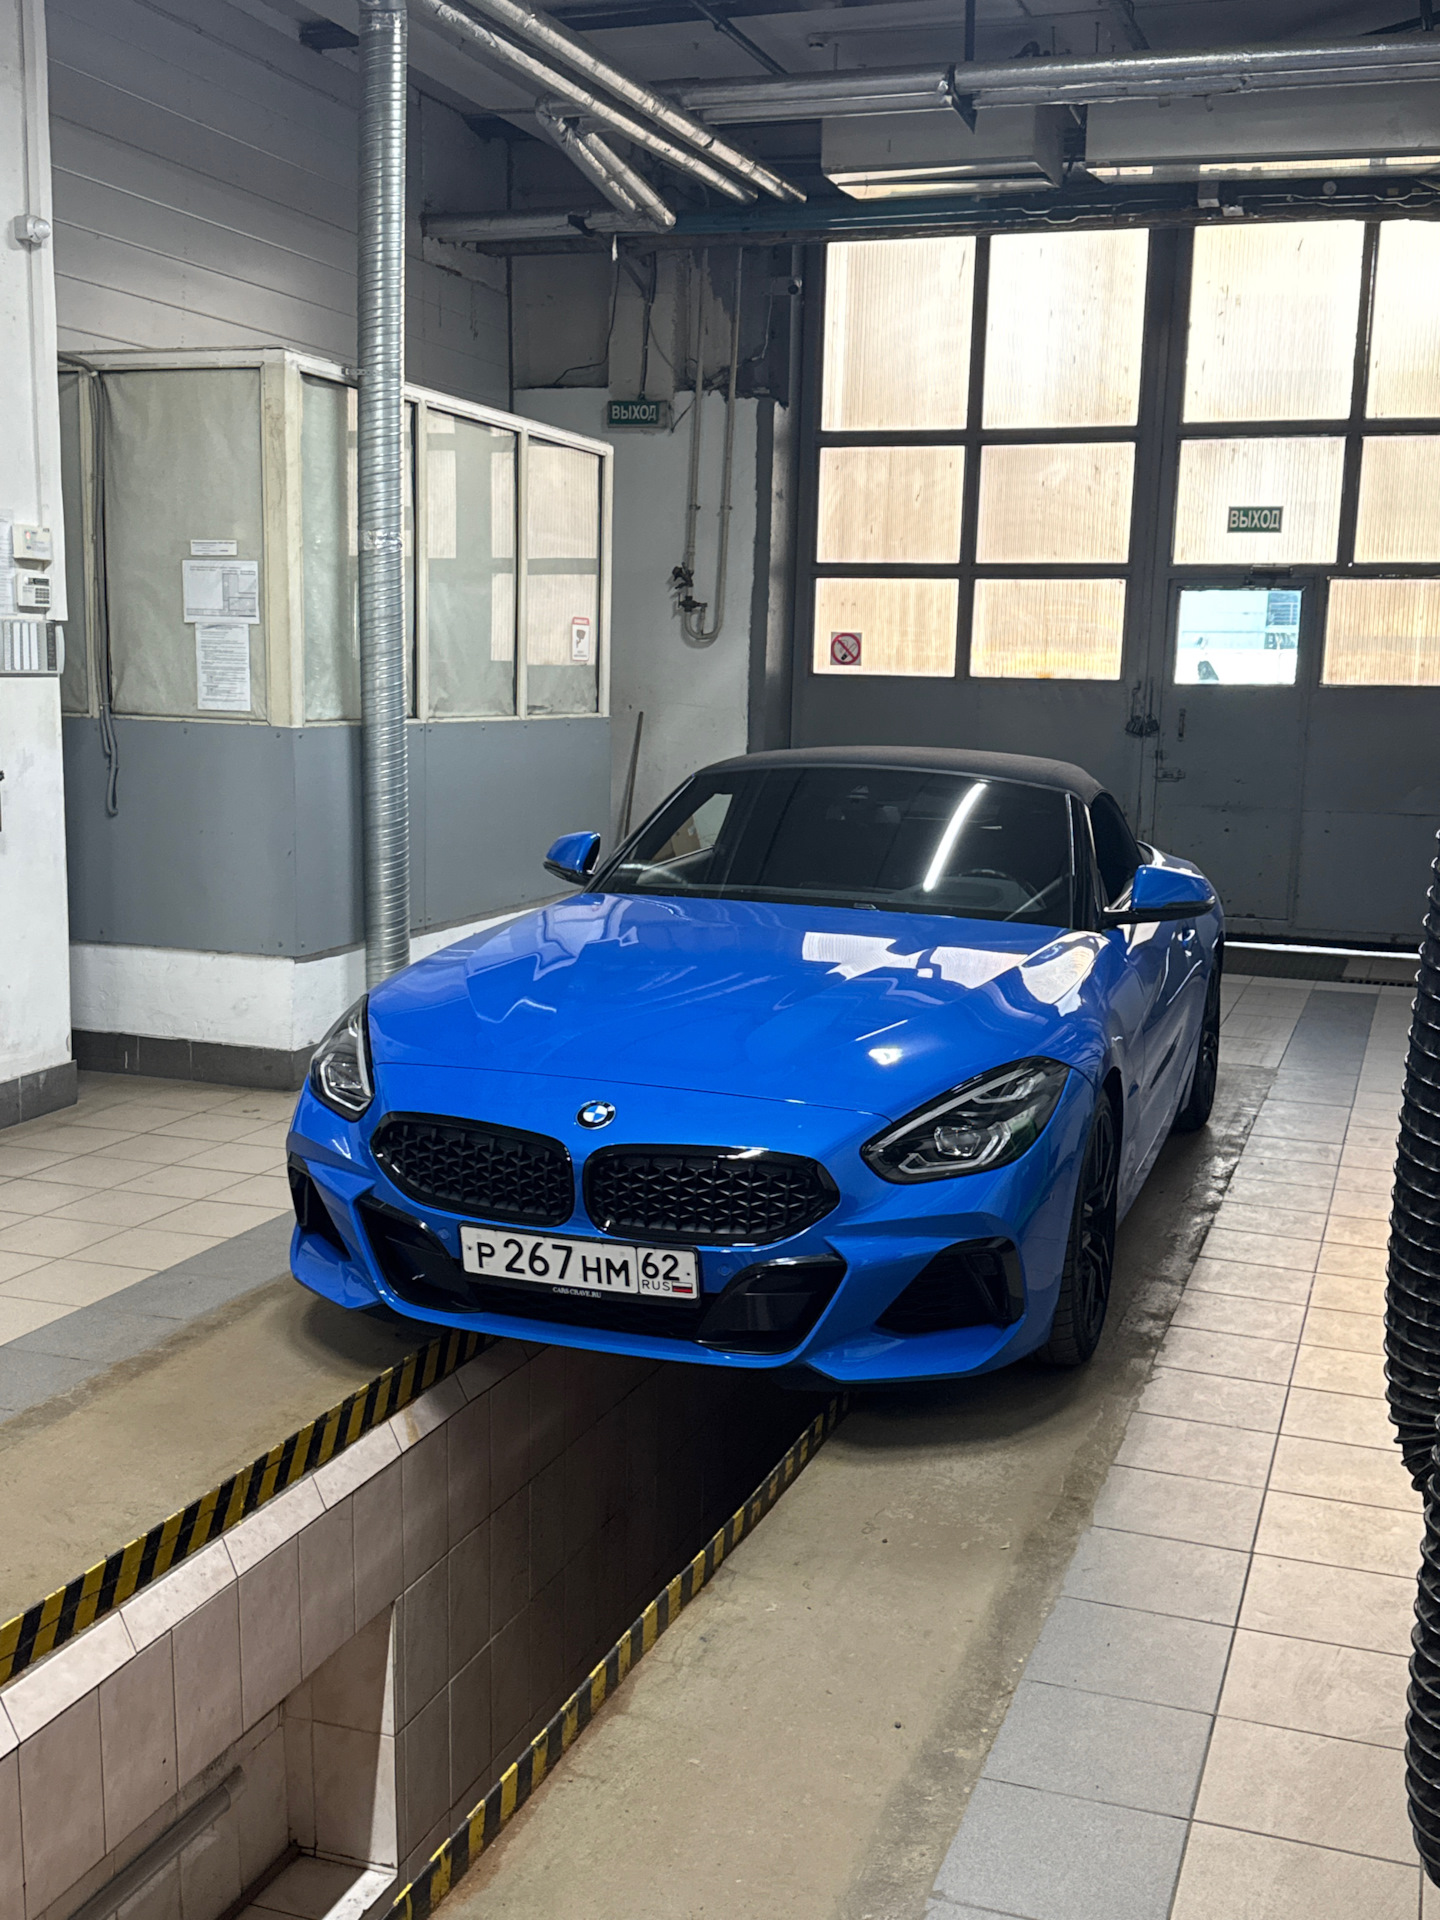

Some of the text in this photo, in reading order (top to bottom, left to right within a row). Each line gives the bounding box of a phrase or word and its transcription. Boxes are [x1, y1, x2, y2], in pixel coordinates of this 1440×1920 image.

[611, 404, 657, 421] ВЫХОД
[1229, 509, 1281, 530] ВЫХОД
[641, 1252, 680, 1281] 62
[641, 1279, 671, 1292] RUS
